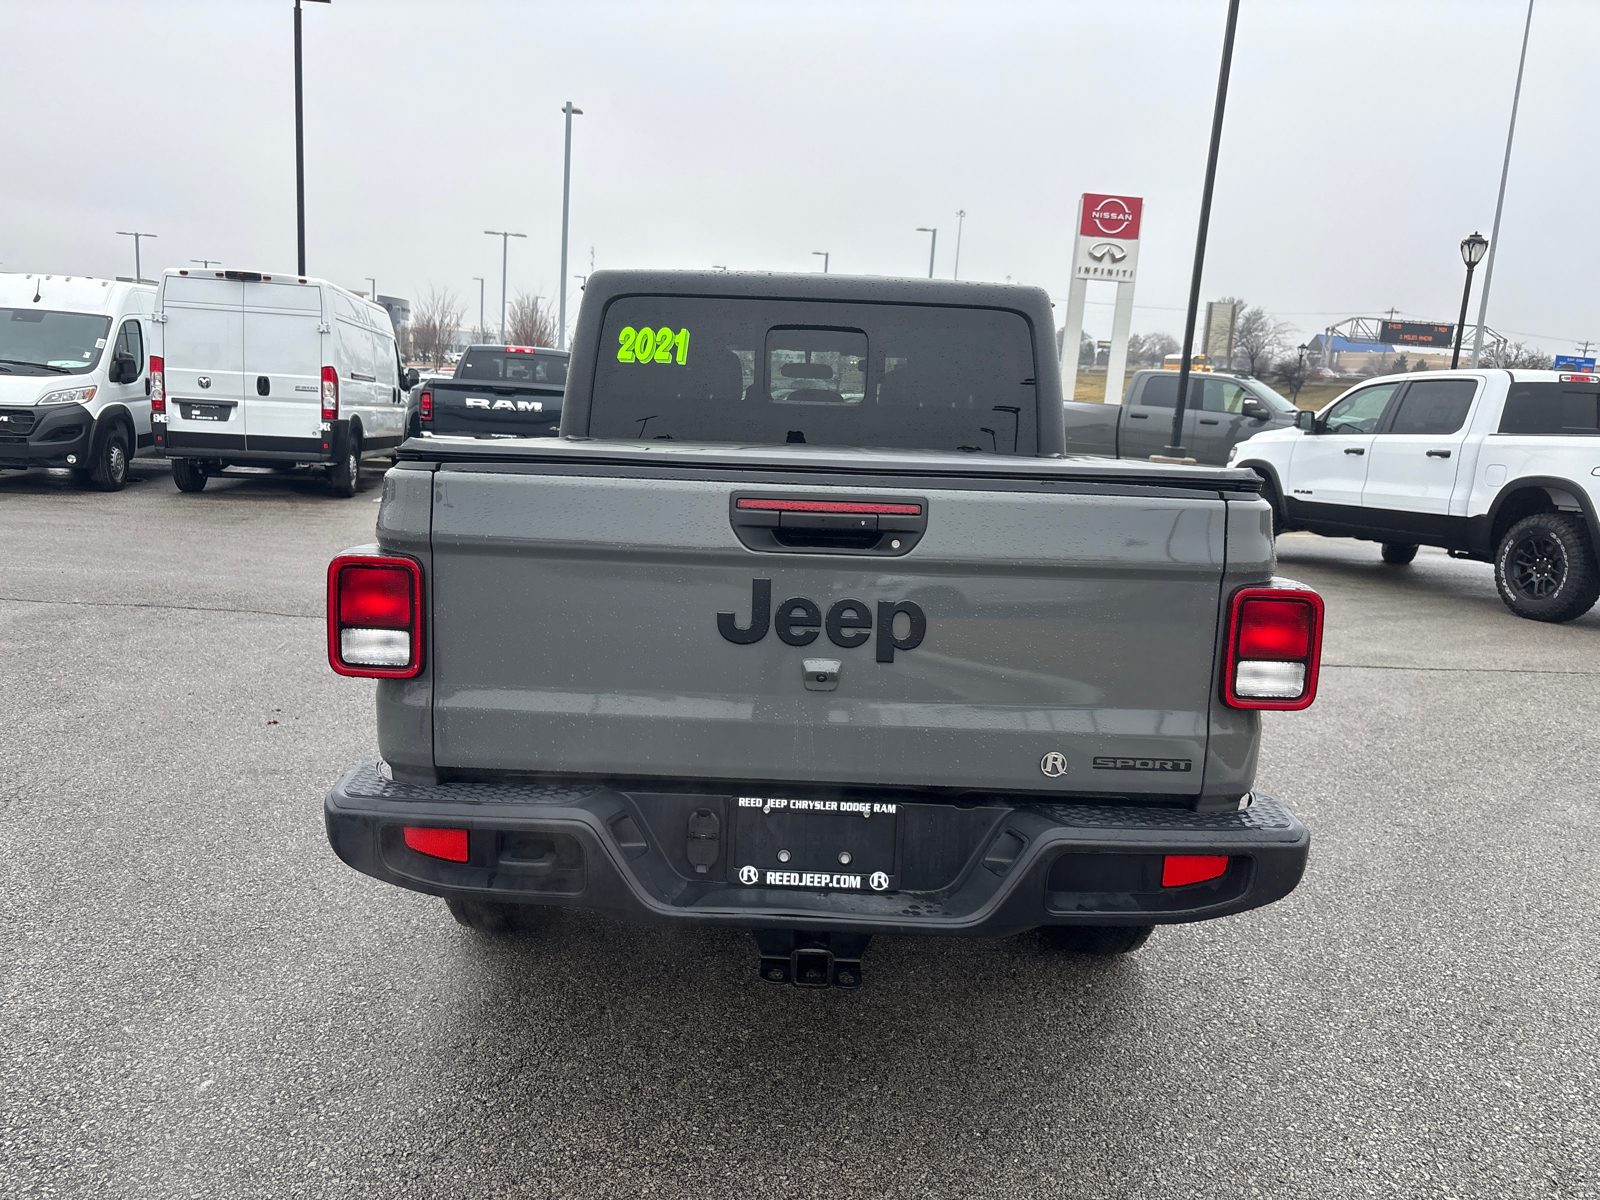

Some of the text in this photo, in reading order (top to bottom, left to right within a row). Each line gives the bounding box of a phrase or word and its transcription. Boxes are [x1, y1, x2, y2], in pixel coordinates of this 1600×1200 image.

[1092, 211, 1132, 221] NISSAN
[1078, 266, 1133, 278] INFINITI
[617, 326, 690, 366] 2021
[465, 398, 543, 413] RAM
[717, 577, 927, 663] Jeep
[1093, 758, 1192, 771] SPORT
[738, 797, 896, 814] REED JEEP CHRYSLER DODGE RAM
[766, 871, 861, 888] REEDJEEP.COM
